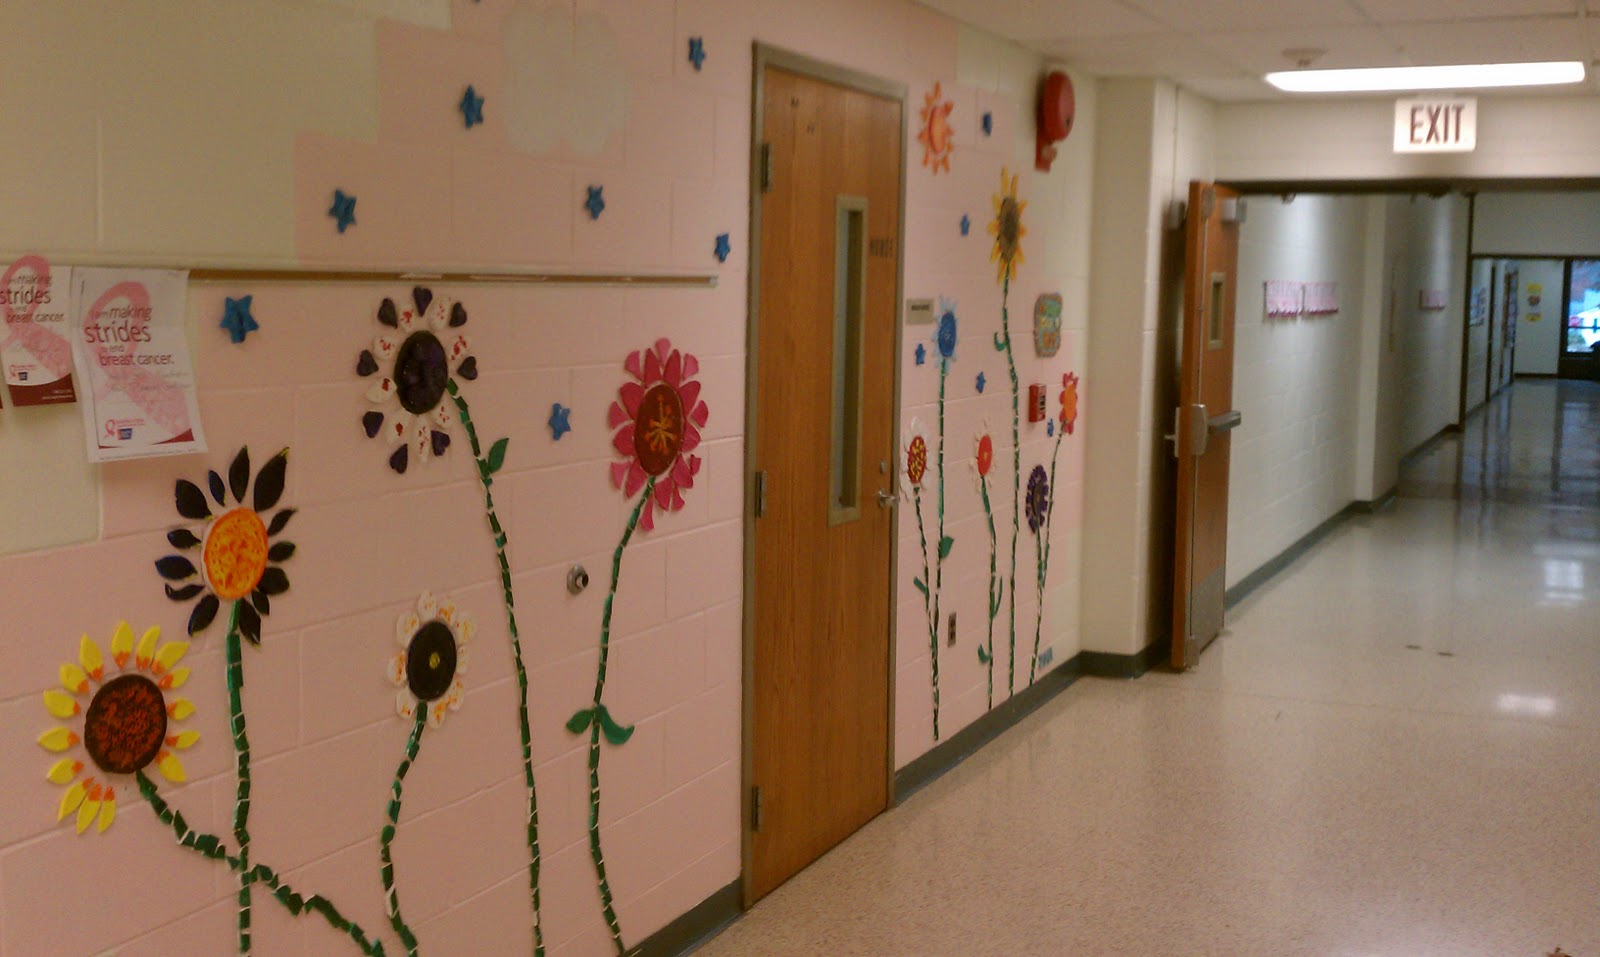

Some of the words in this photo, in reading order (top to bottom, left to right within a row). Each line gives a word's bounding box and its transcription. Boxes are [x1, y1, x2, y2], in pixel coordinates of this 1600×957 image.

[1410, 104, 1465, 144] EXIT
[0, 285, 51, 304] strides
[109, 304, 152, 321] making
[84, 320, 151, 343] strides
[98, 352, 136, 366] breast
